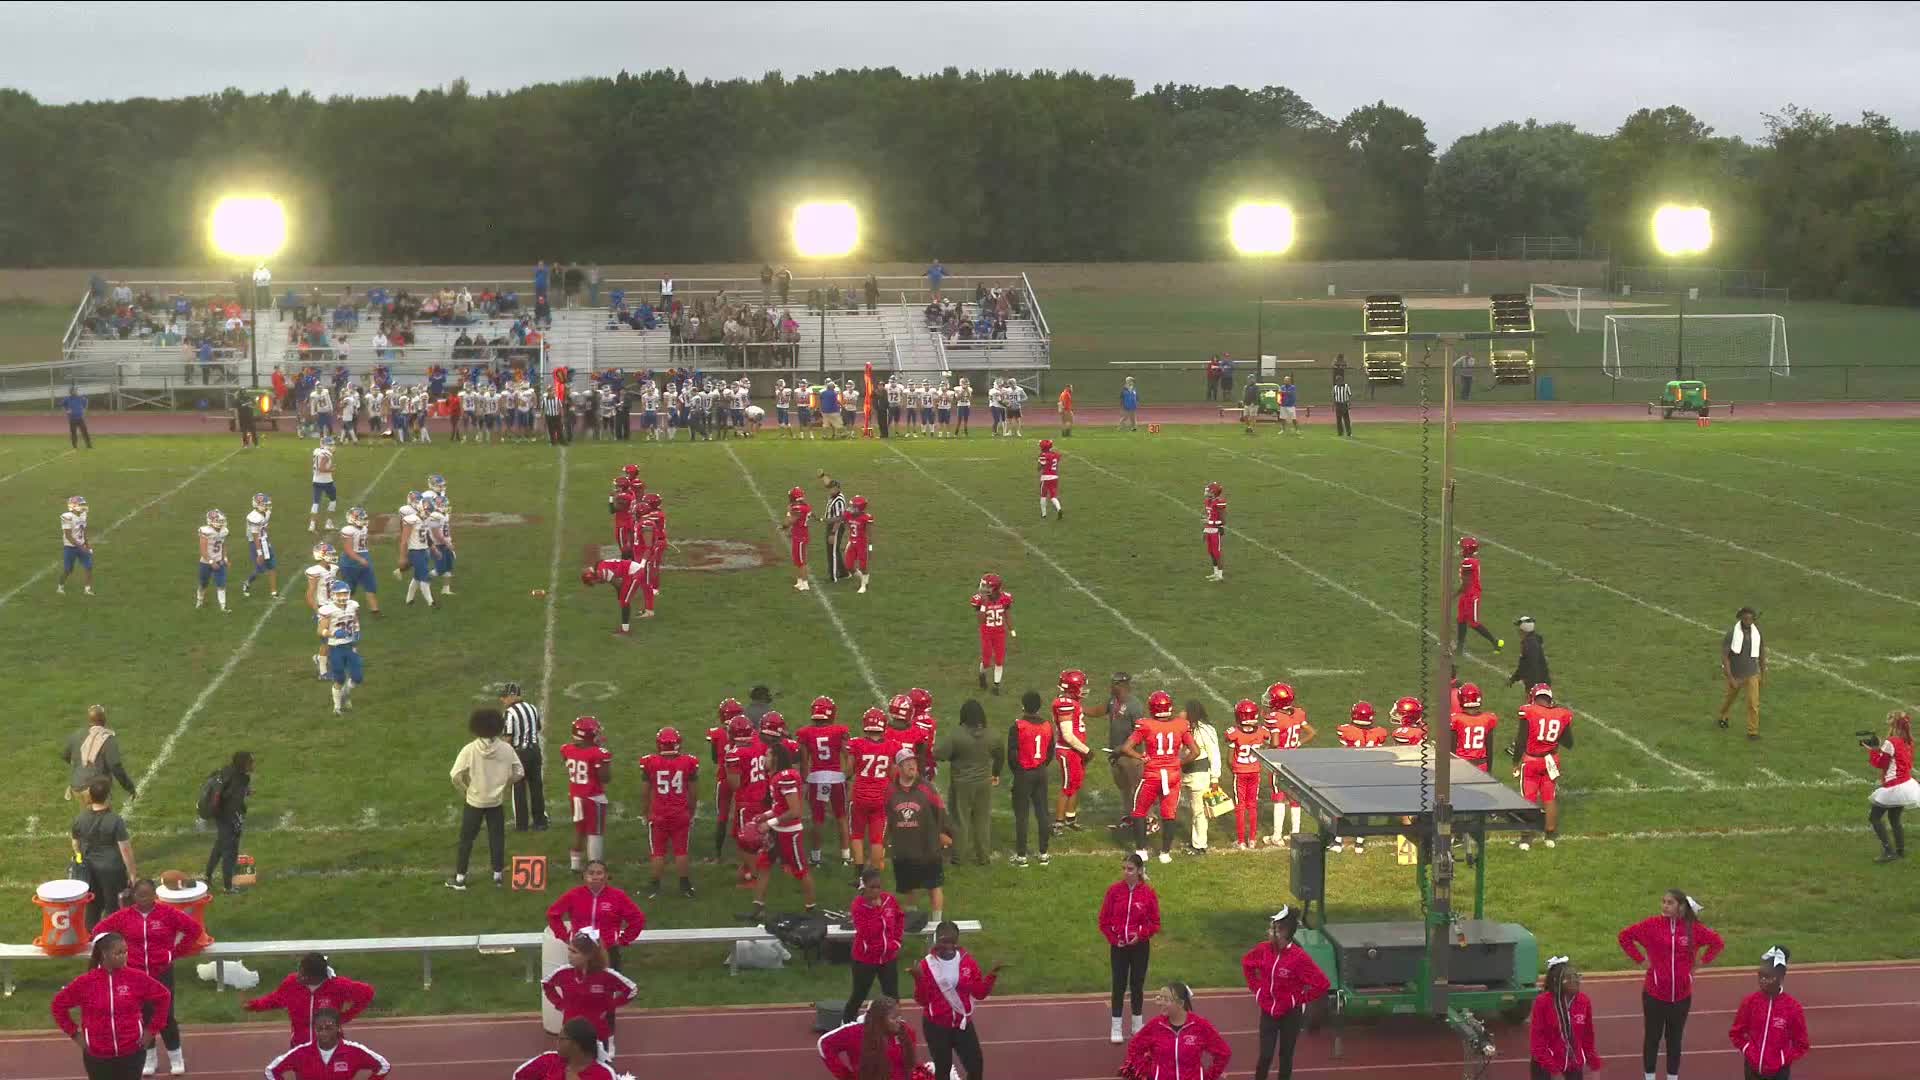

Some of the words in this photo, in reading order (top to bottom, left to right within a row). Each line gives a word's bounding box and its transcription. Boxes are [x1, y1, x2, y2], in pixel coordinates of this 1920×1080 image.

[849, 523, 858, 538] 3
[985, 608, 1005, 627] 25
[1284, 725, 1302, 748] 15
[1463, 726, 1486, 750] 12
[1536, 718, 1562, 743] 18
[815, 736, 831, 760] 5
[1033, 734, 1042, 759] 1
[1154, 731, 1174, 756] 11
[860, 754, 889, 778] 72
[656, 770, 684, 795] 54
[512, 858, 544, 888] 50
[51, 910, 71, 930] G
